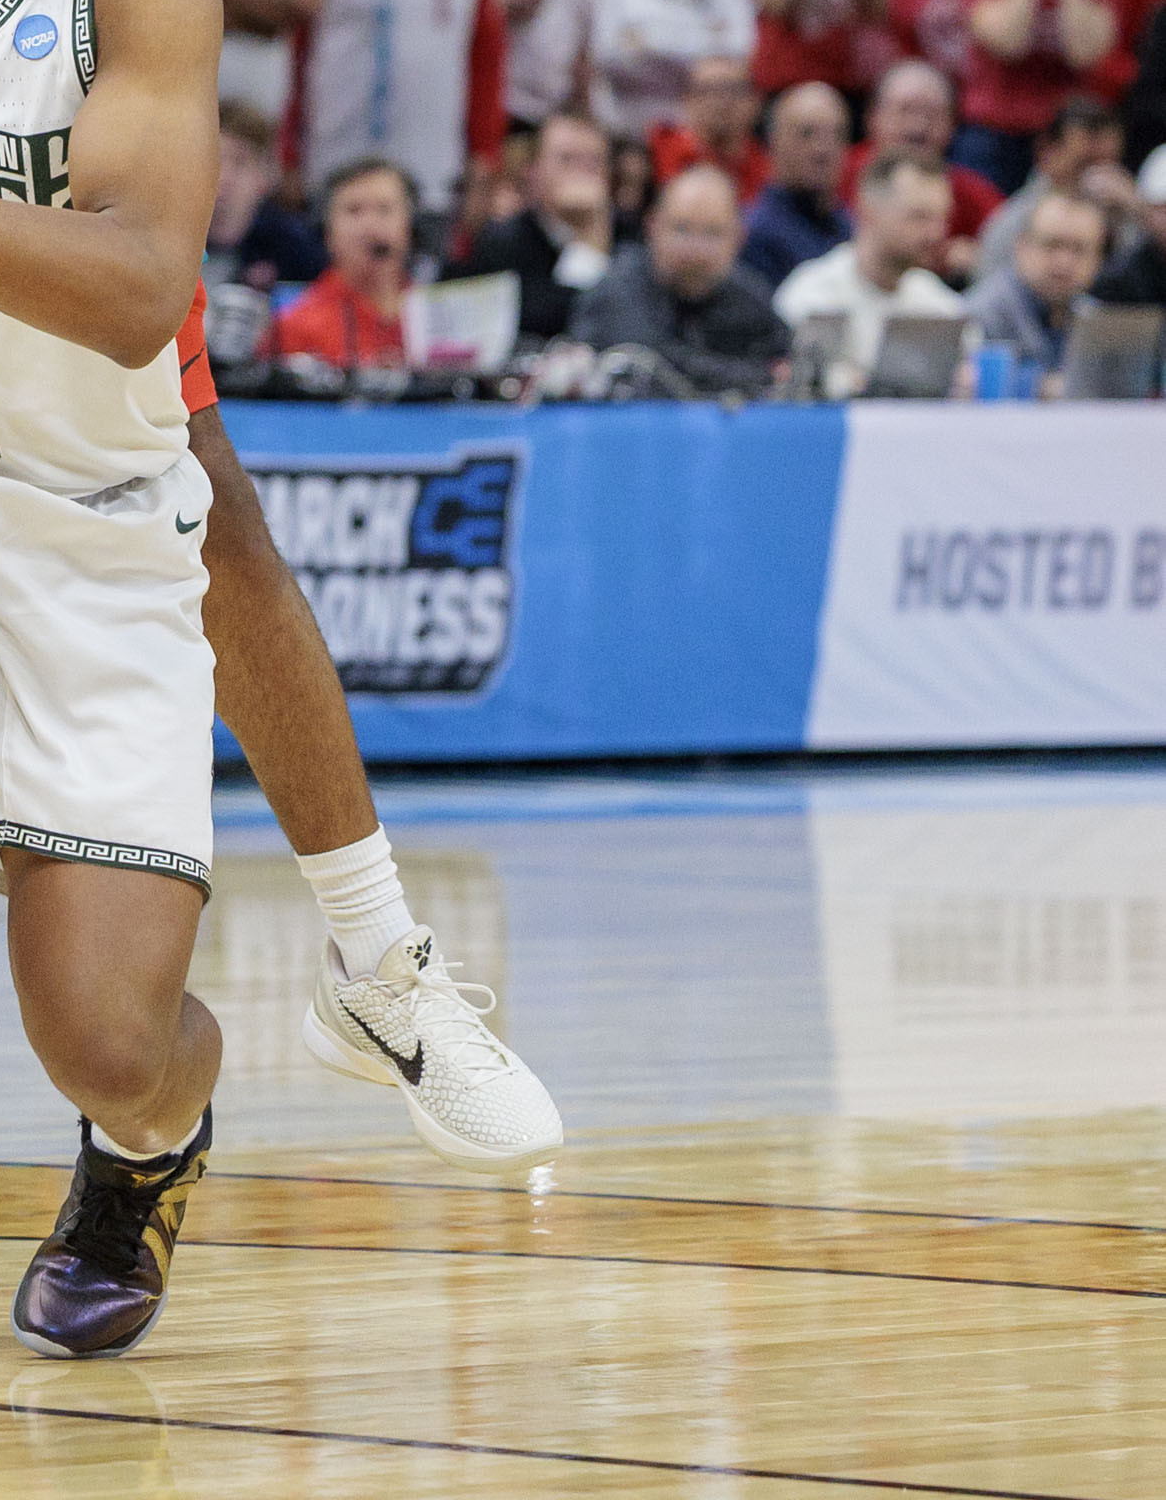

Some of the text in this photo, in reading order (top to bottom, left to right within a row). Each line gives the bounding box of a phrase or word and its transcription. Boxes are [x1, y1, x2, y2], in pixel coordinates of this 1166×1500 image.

[20, 30, 56, 51] NCAA
[252, 471, 421, 568] ARCH
[296, 568, 510, 663] DNESS
[894, 529, 1115, 613] HOSTED
